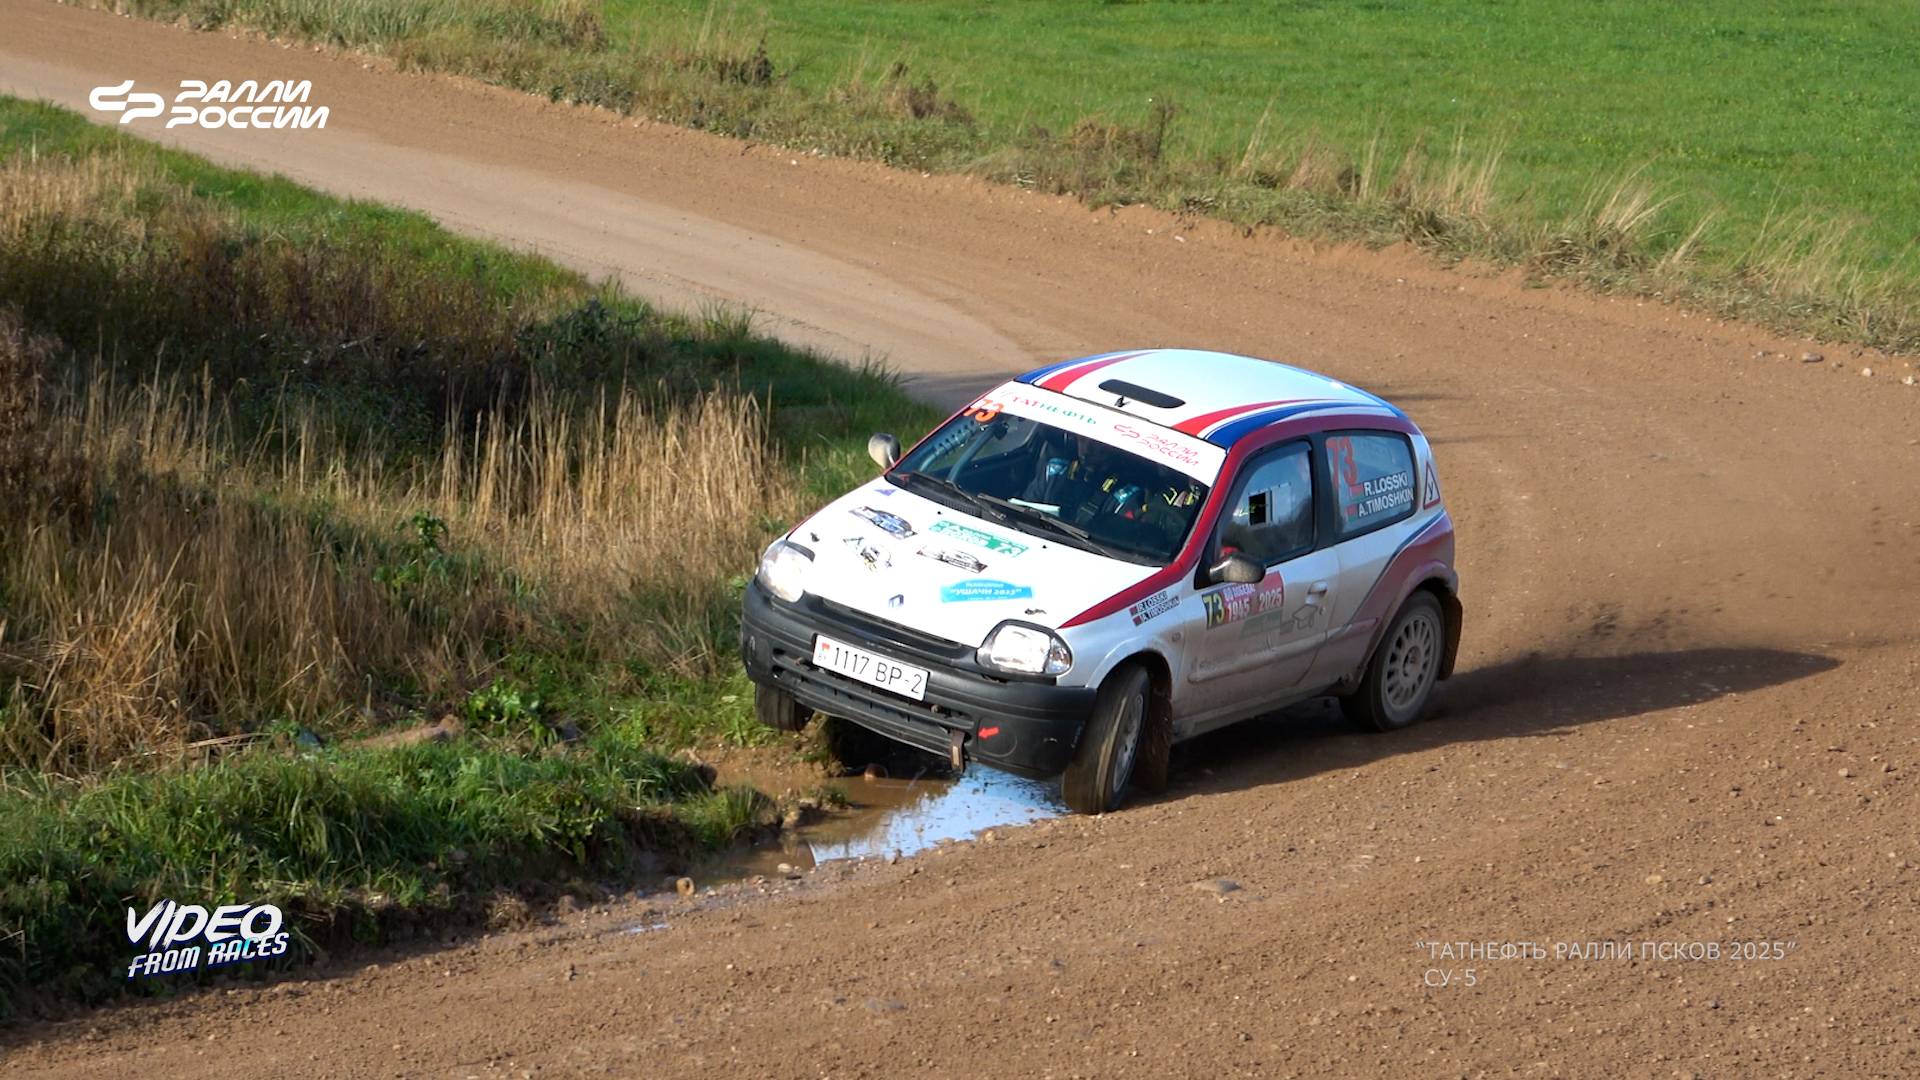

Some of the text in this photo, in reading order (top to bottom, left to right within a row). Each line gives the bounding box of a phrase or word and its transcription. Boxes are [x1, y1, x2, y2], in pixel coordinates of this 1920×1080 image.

[1325, 436, 1358, 490] 73
[1364, 471, 1408, 497] R.LOSSKI
[1358, 488, 1414, 518] A.TIMOSHKIN
[1202, 592, 1225, 628] 73
[1259, 587, 1283, 612] 2025
[834, 647, 923, 694] 1117 BP-2
